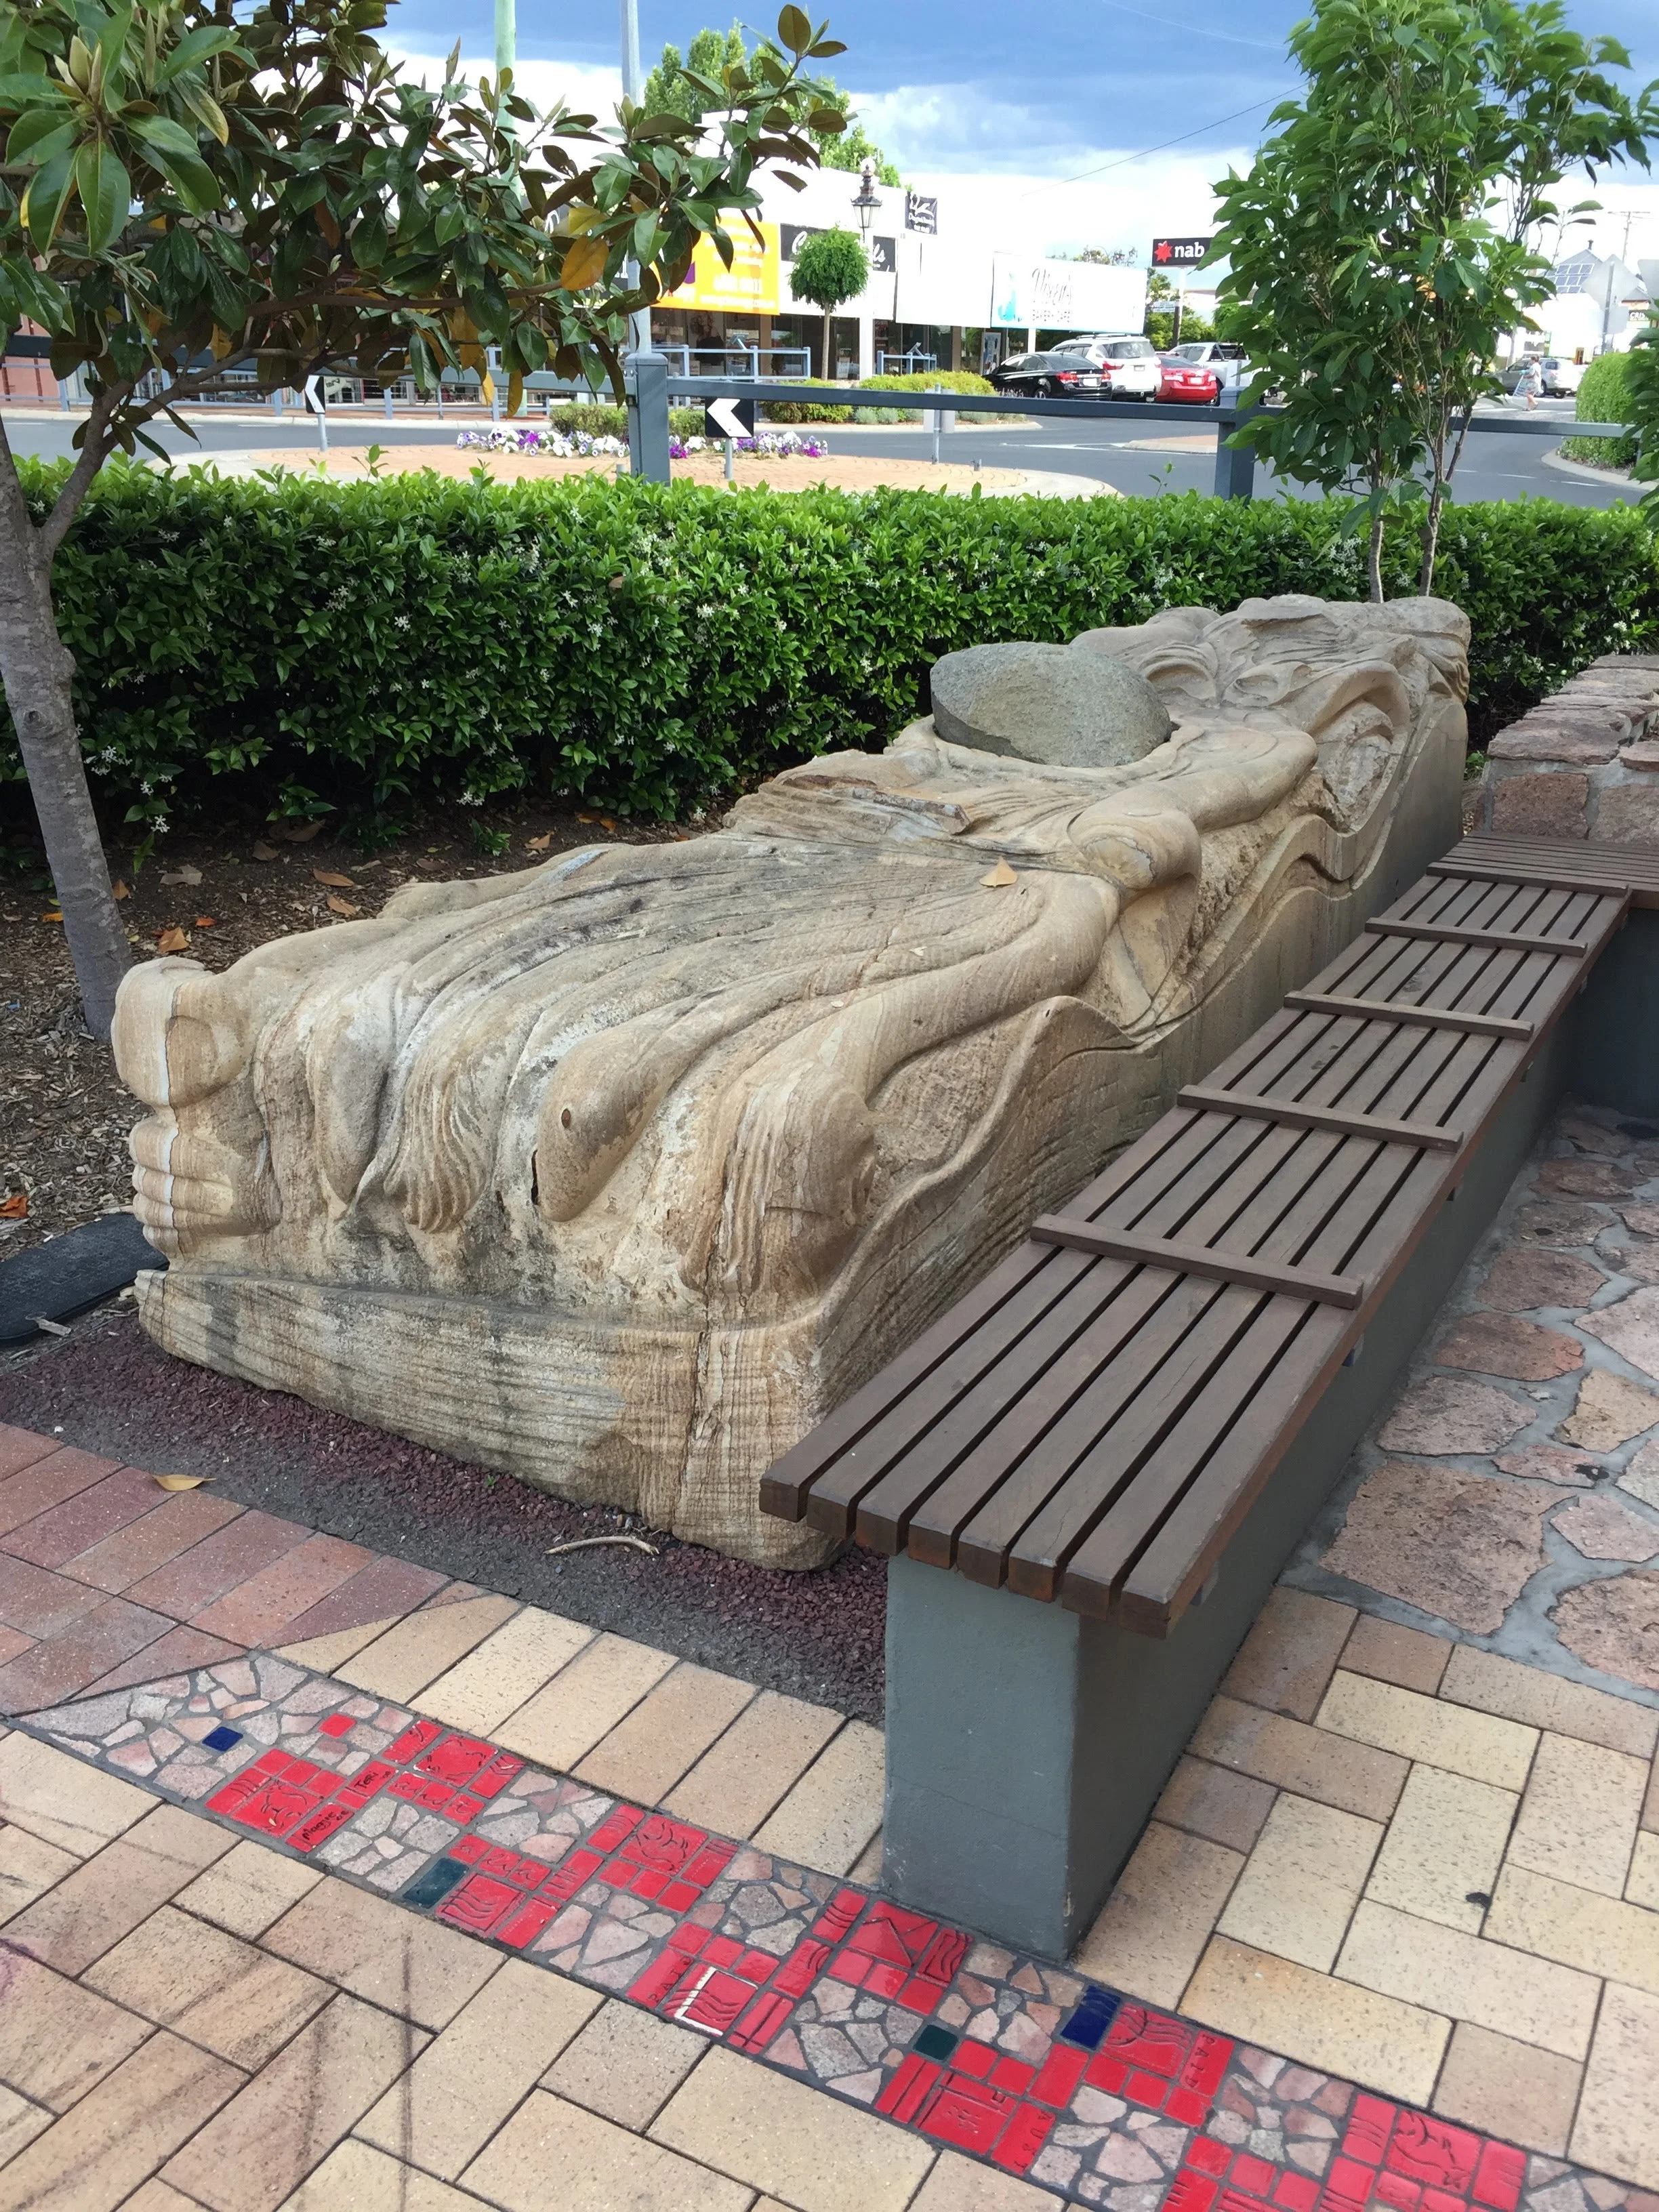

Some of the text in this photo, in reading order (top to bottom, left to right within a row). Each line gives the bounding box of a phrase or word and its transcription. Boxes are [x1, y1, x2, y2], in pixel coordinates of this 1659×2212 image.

[1174, 241, 1205, 258] nab
[302, 1811, 337, 1841] Maggie
[1185, 2034, 1215, 2088] PAID
